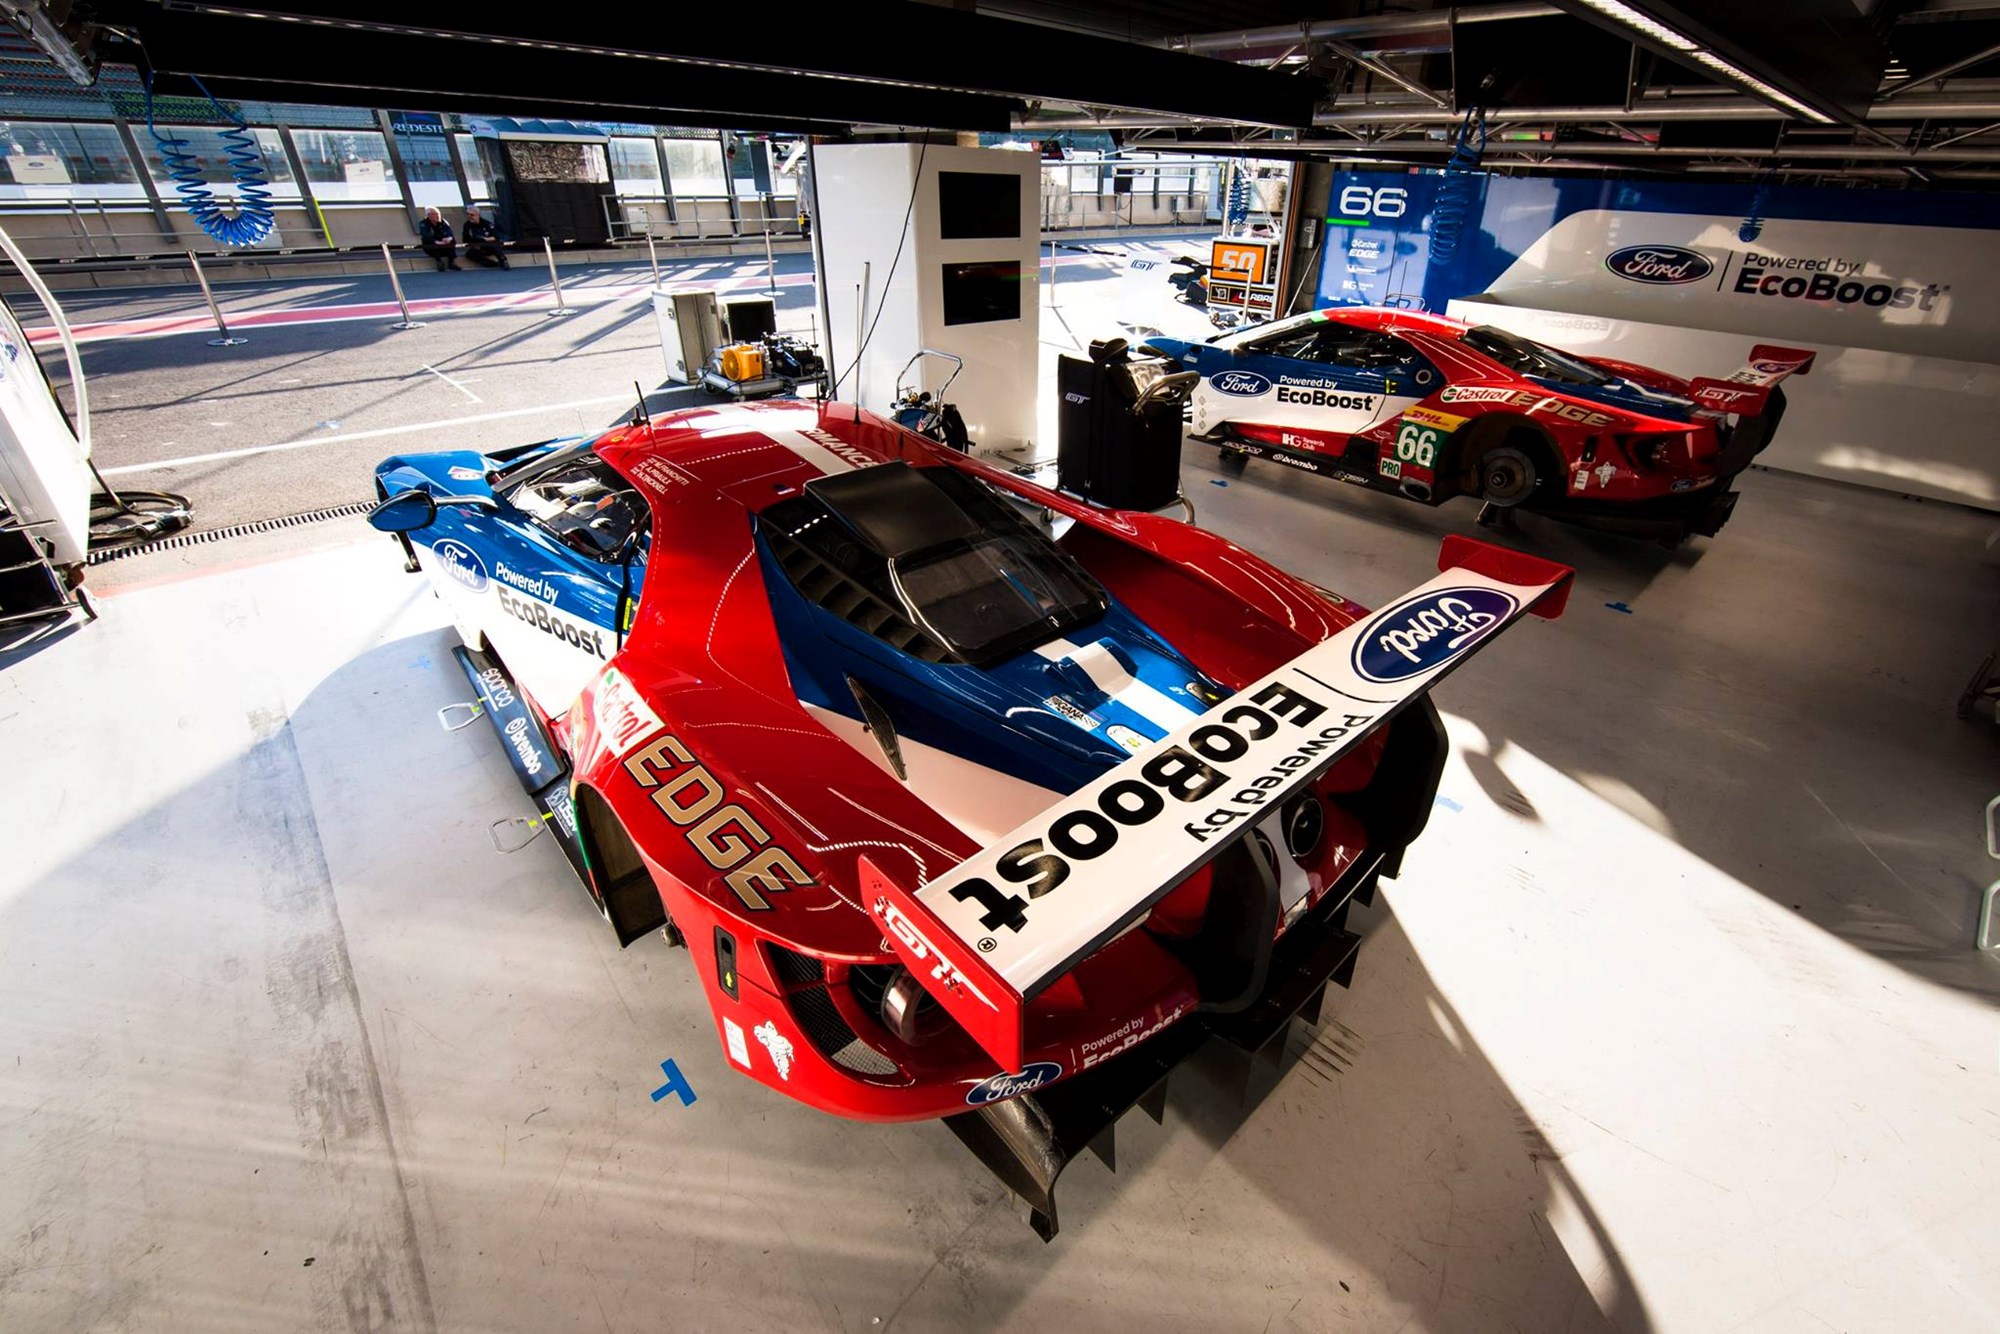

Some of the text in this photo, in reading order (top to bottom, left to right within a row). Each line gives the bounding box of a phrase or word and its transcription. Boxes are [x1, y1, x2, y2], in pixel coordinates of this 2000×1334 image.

[1340, 186, 1408, 217] 66
[1222, 250, 1257, 269] 50
[1348, 248, 1380, 259] EDGE
[1744, 253, 1860, 276] Powered by
[1734, 268, 1942, 311] EcoBoost
[1277, 387, 1373, 411] EcoBoost
[1279, 375, 1338, 390] Powered by
[1455, 387, 1508, 401] Castrol
[1411, 410, 1450, 427] DHL
[1510, 391, 1616, 427] EDGE
[1282, 433, 1302, 447] IHG
[1397, 425, 1437, 467] 66
[1281, 456, 1318, 471] brembo
[1382, 460, 1399, 477] PRO
[496, 562, 559, 605] Powered by
[497, 585, 606, 660] EcoBoost
[1378, 597, 1497, 666] Ford
[482, 668, 515, 707] sparco
[510, 726, 542, 775] brembo
[1184, 714, 1372, 842] Powered by
[622, 734, 816, 911] EDGE
[949, 681, 1328, 934] EcoBoost
[1081, 1016, 1146, 1055] Powered by
[986, 1069, 1045, 1101] Ford
